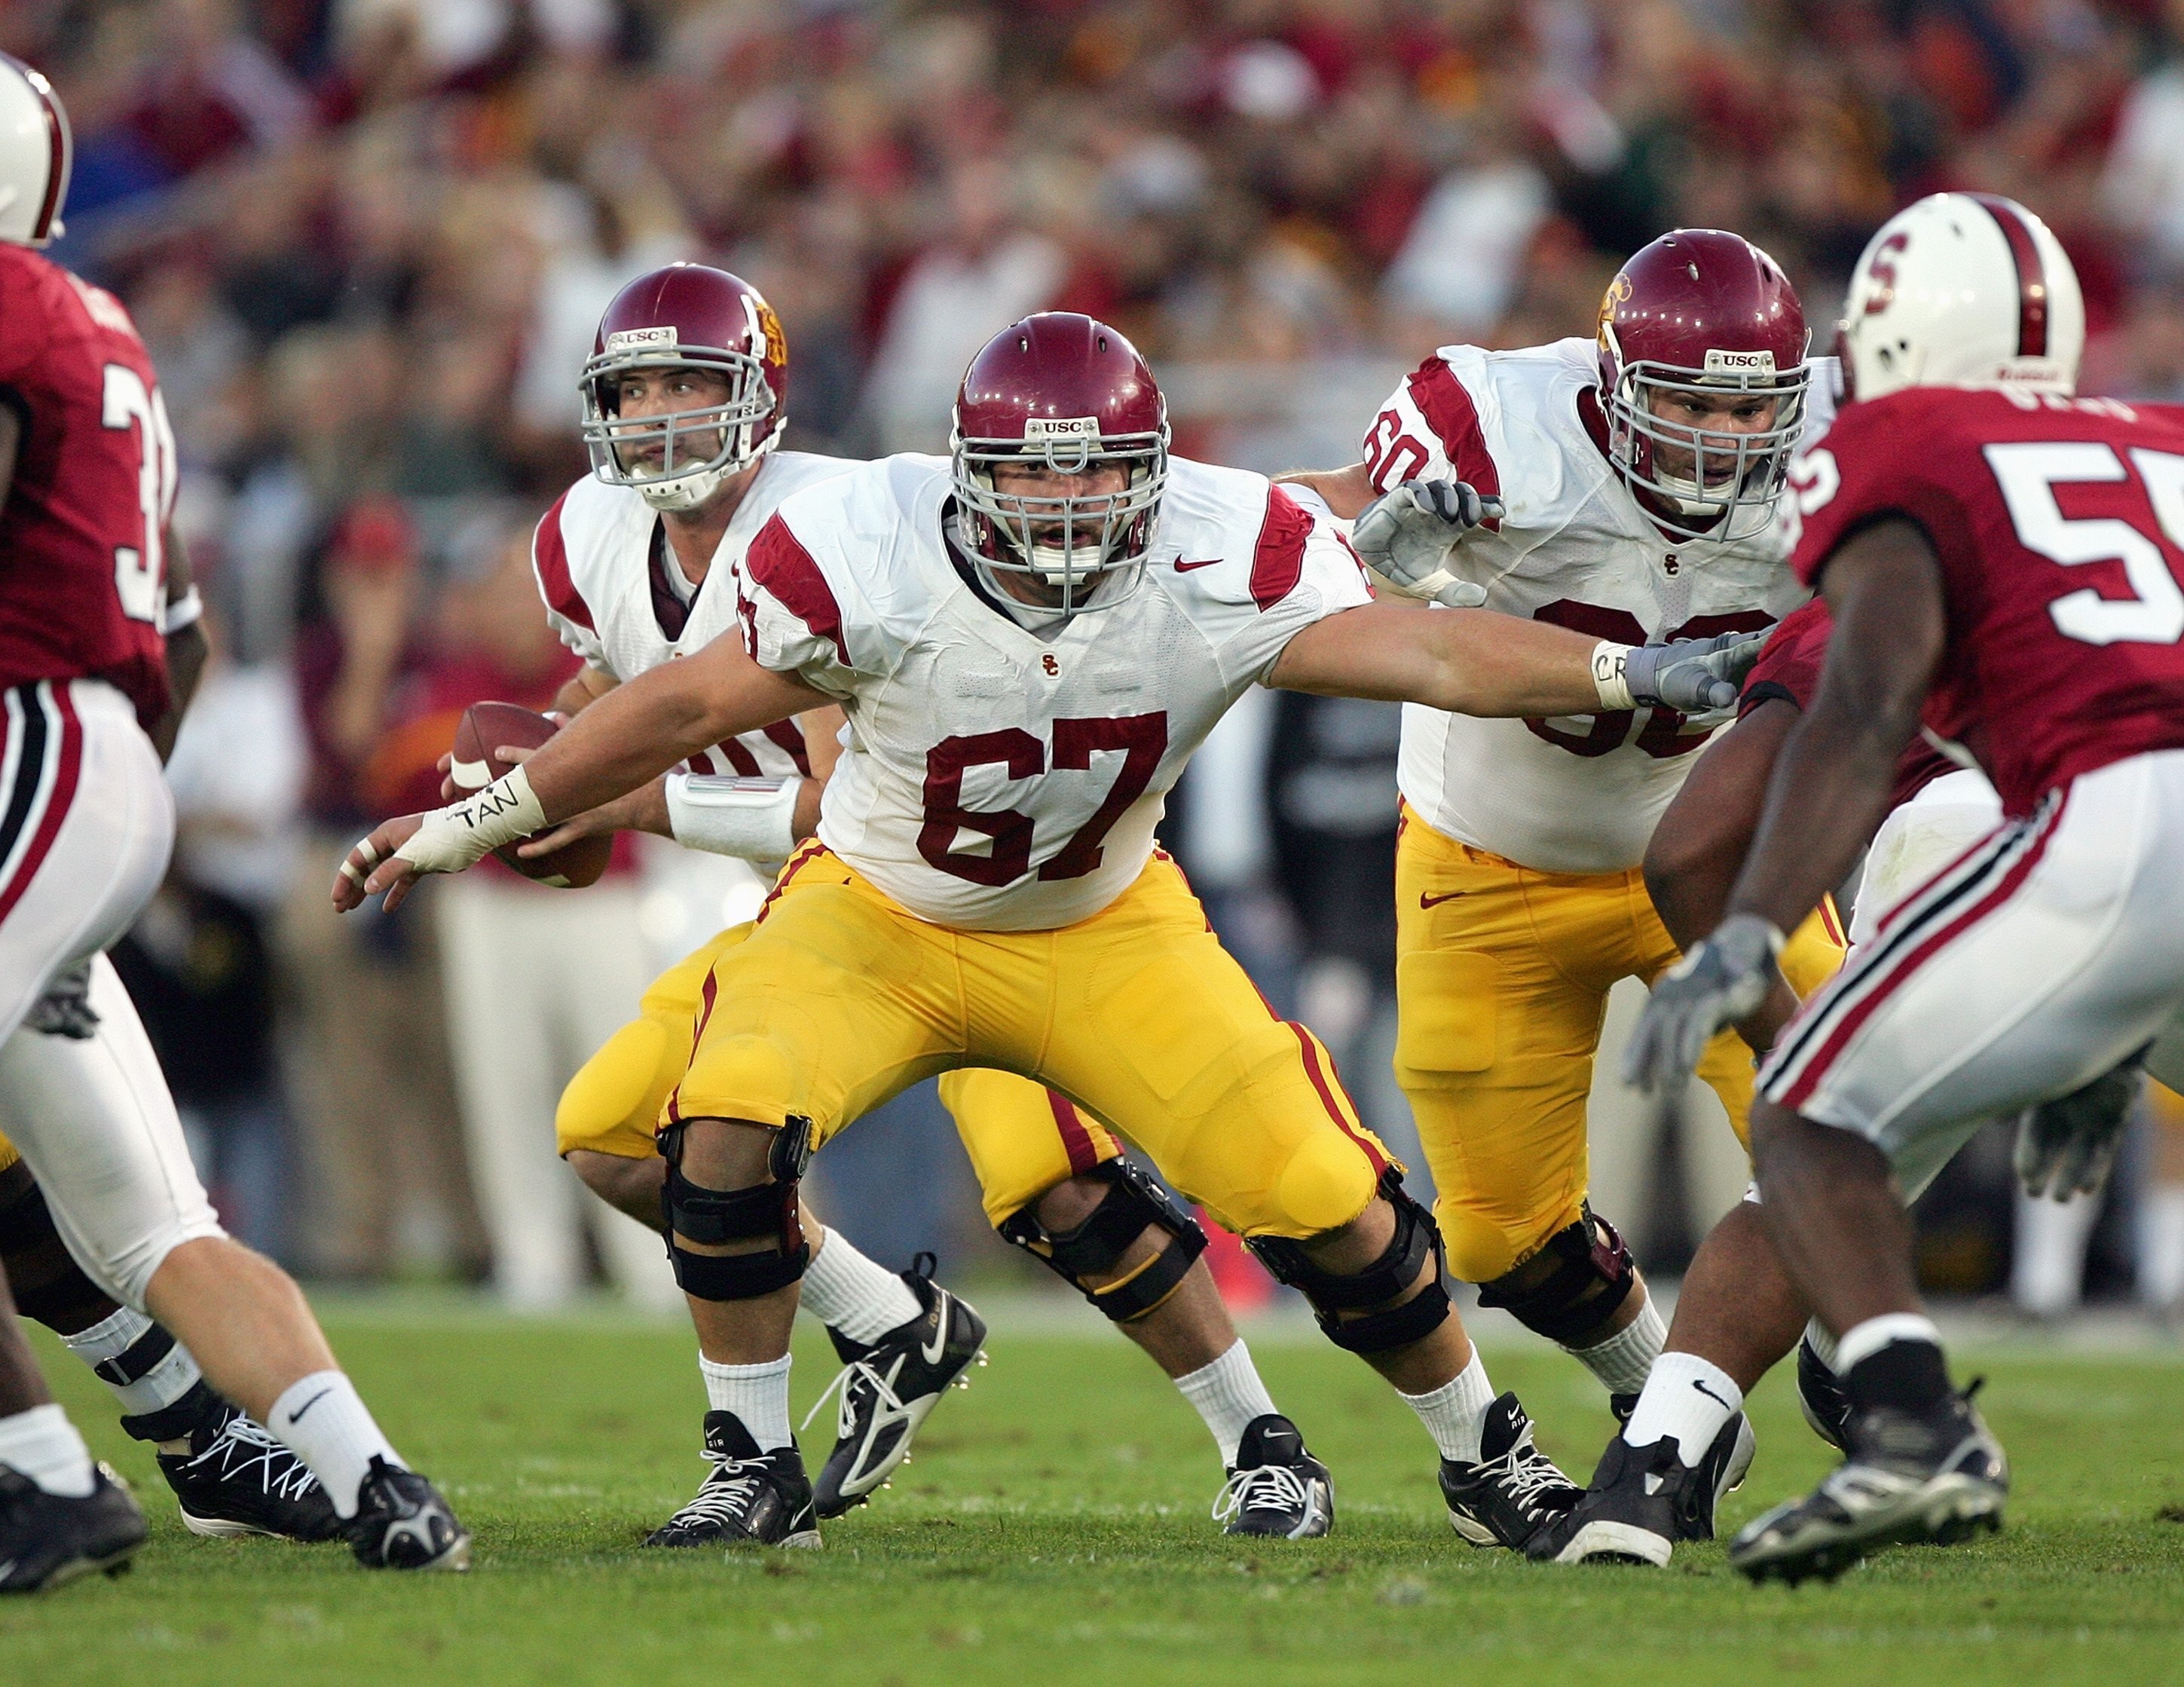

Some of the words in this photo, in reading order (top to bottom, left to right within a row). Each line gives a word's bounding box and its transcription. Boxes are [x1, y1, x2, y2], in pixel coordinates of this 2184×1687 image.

[1864, 231, 1908, 314] S
[626, 331, 660, 344] USC
[1723, 355, 1758, 367] USC
[1044, 421, 1081, 433] USC
[1981, 441, 2184, 647] 5
[454, 779, 518, 828] TAN
[916, 710, 1167, 887] 67
[1512, 1416, 1525, 1429] AIR
